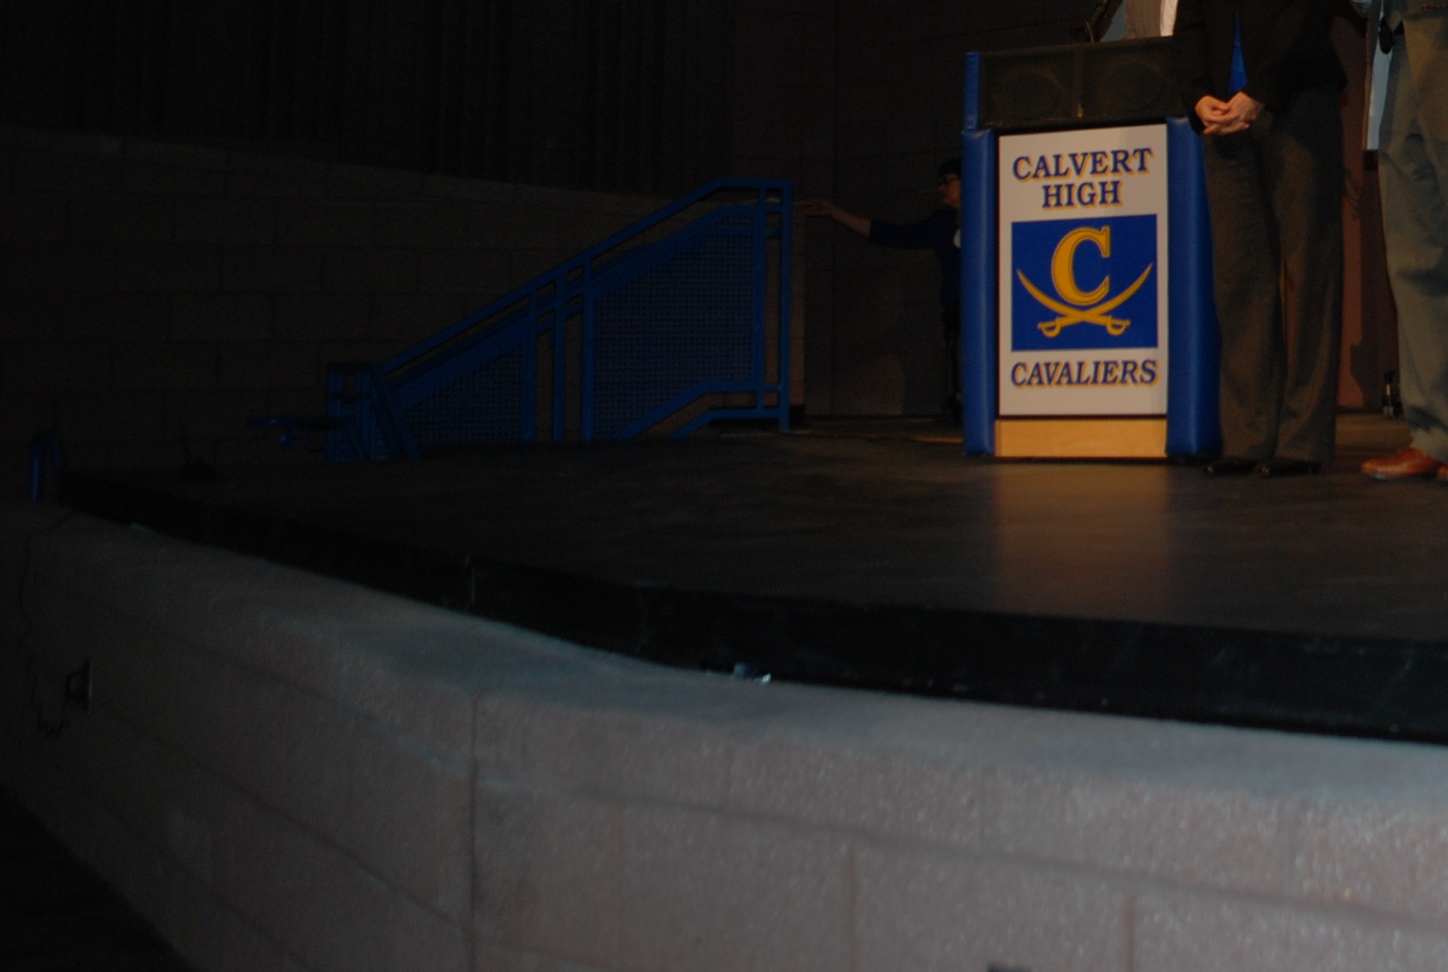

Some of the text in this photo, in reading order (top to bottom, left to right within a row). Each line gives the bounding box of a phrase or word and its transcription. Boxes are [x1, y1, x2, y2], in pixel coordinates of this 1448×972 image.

[1012, 147, 1153, 181] CALVERT
[1041, 181, 1122, 209] HIGH
[1051, 226, 1111, 306] C
[1010, 360, 1157, 388] CAVALIERS
